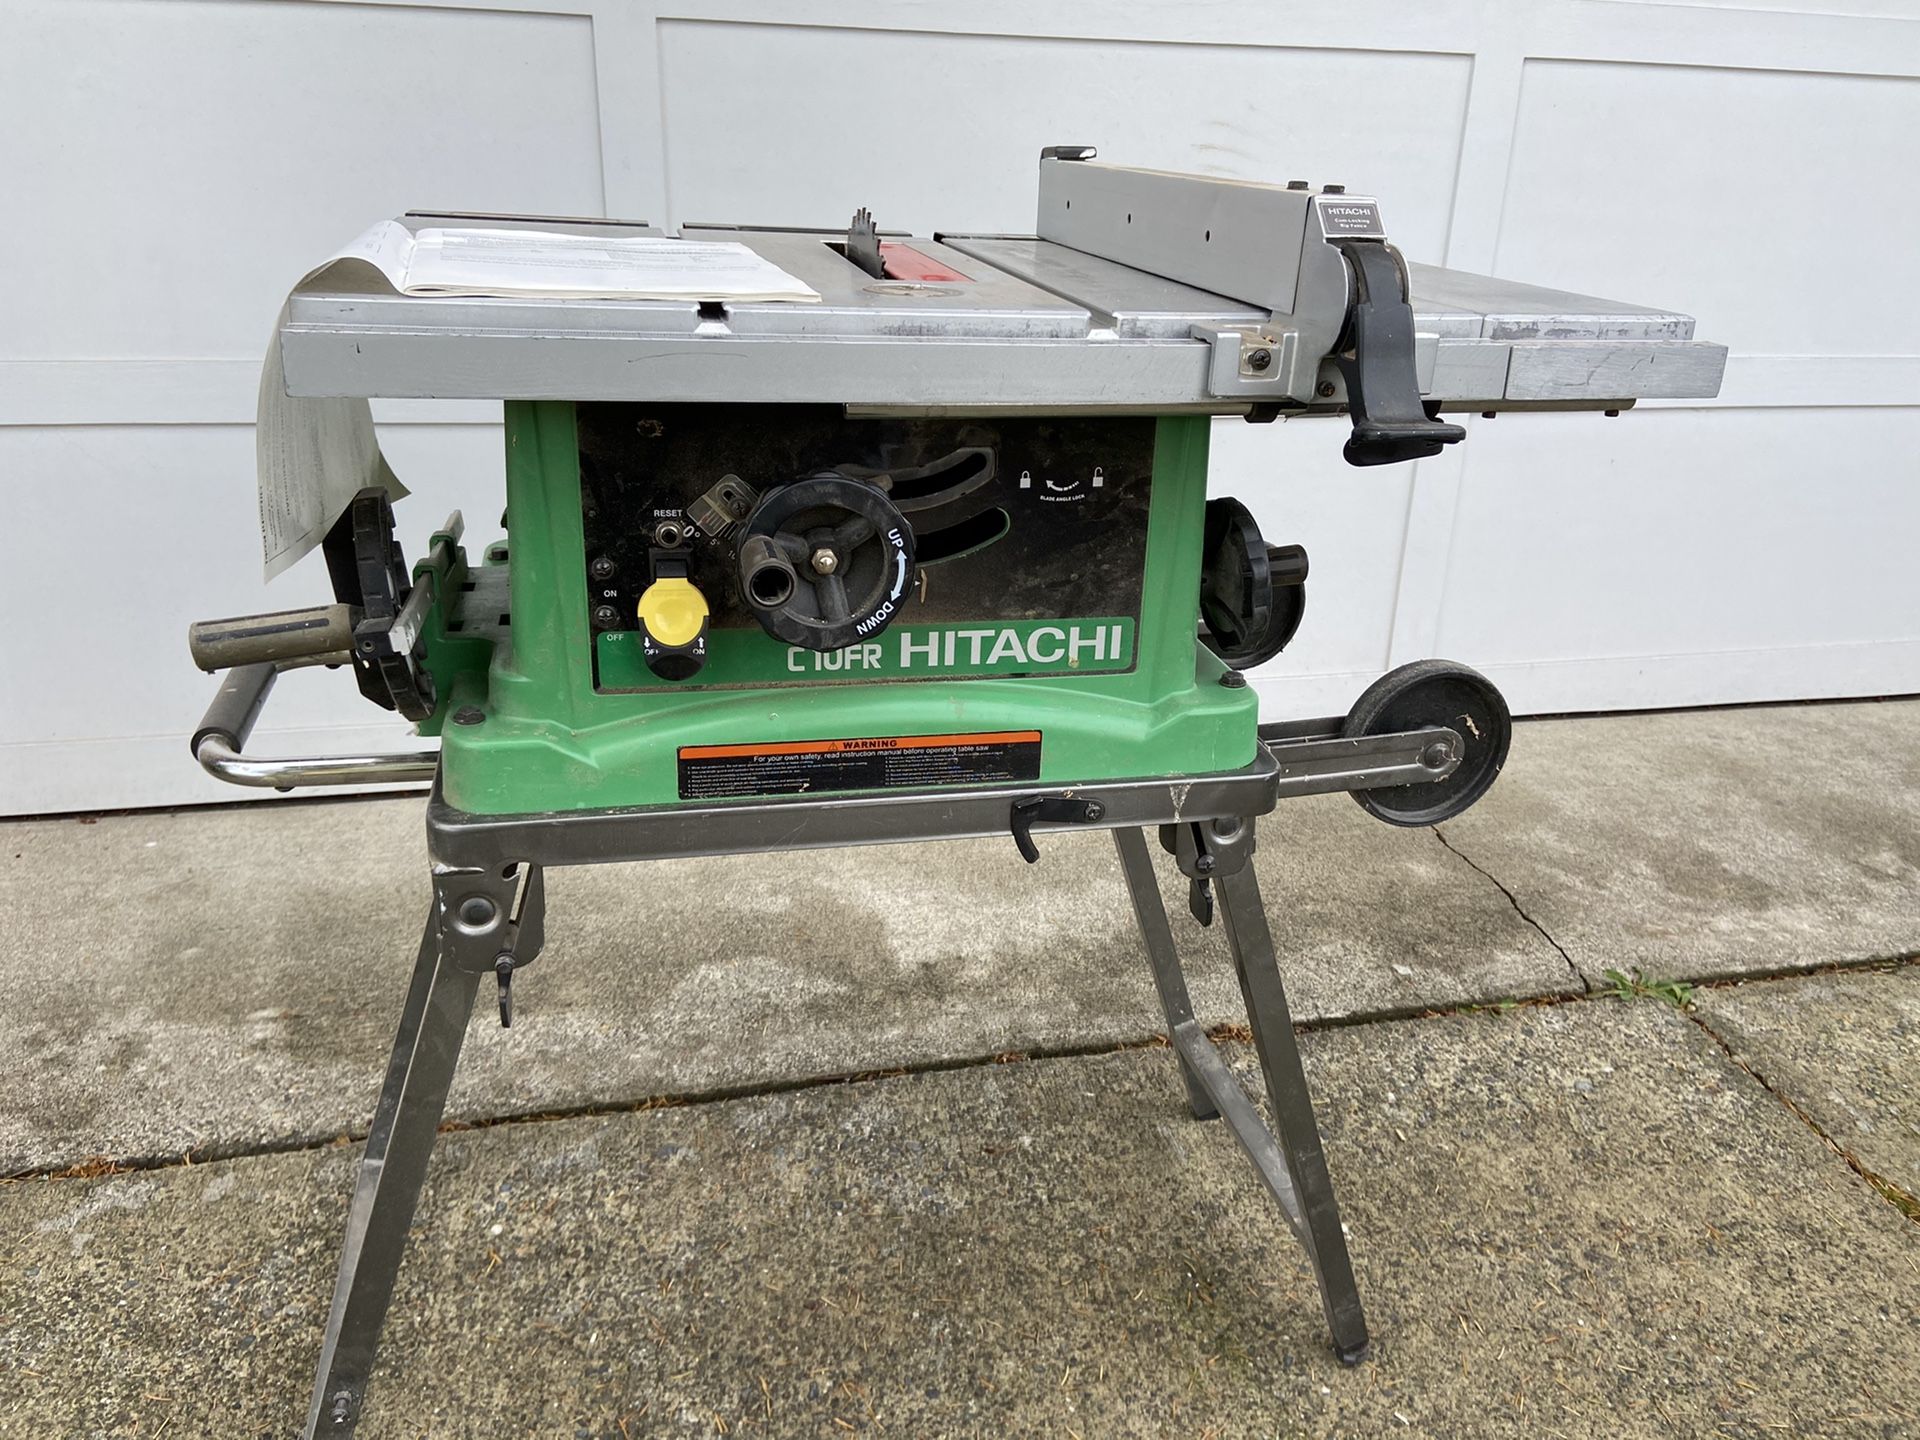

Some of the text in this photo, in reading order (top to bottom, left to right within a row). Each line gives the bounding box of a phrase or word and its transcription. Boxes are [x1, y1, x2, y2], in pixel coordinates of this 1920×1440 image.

[653, 509, 683, 517] RESET
[888, 528, 904, 548] UP
[603, 590, 617, 598] ON
[856, 601, 894, 635] DOWN
[607, 634, 624, 642] OFF
[900, 625, 1122, 668] HITACHI
[843, 739, 897, 750] WARNING
[766, 755, 783, 763] your
[824, 751, 840, 759] read
[841, 750, 876, 758] instruction
[877, 748, 902, 756] manual
[903, 747, 924, 755] before
[926, 746, 957, 755] operating
